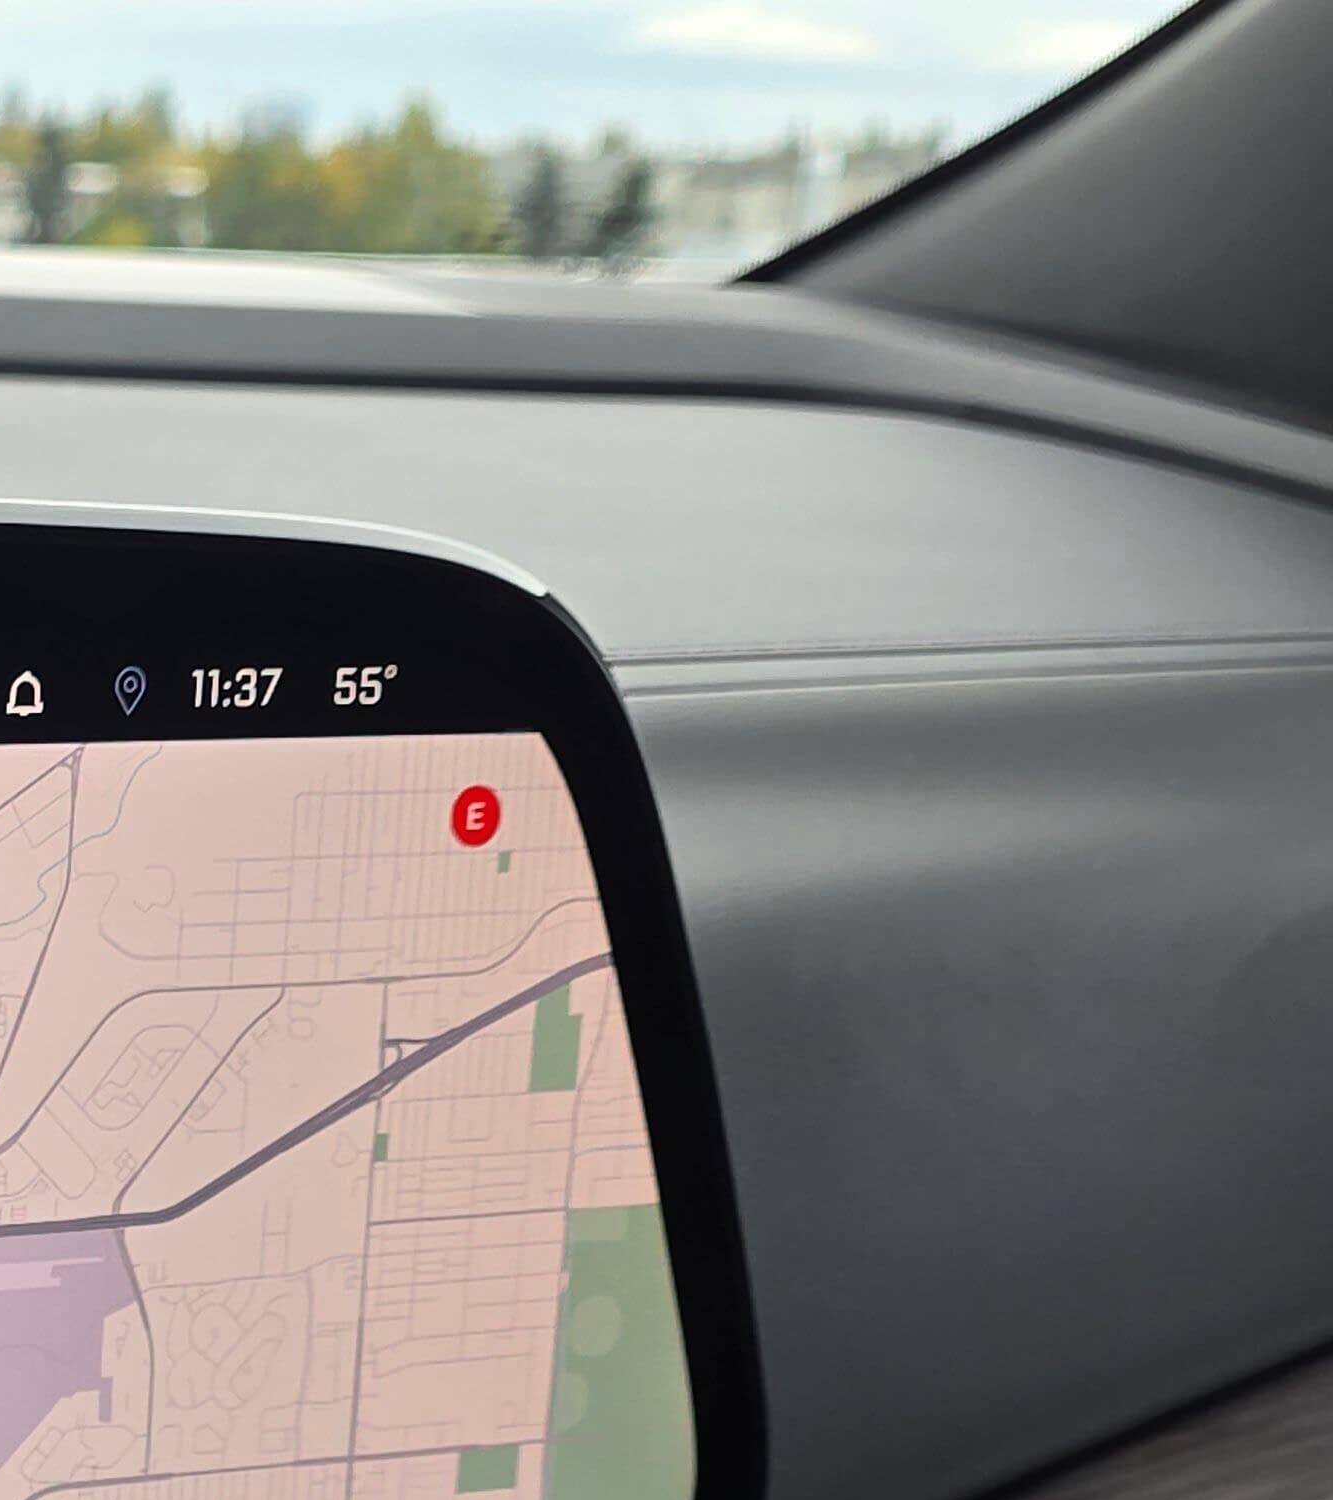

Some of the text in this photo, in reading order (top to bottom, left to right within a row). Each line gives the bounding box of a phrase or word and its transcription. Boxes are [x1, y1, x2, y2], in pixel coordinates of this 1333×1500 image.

[190, 667, 284, 708] 11:37
[332, 664, 399, 706] 55°
[464, 800, 488, 832] E
